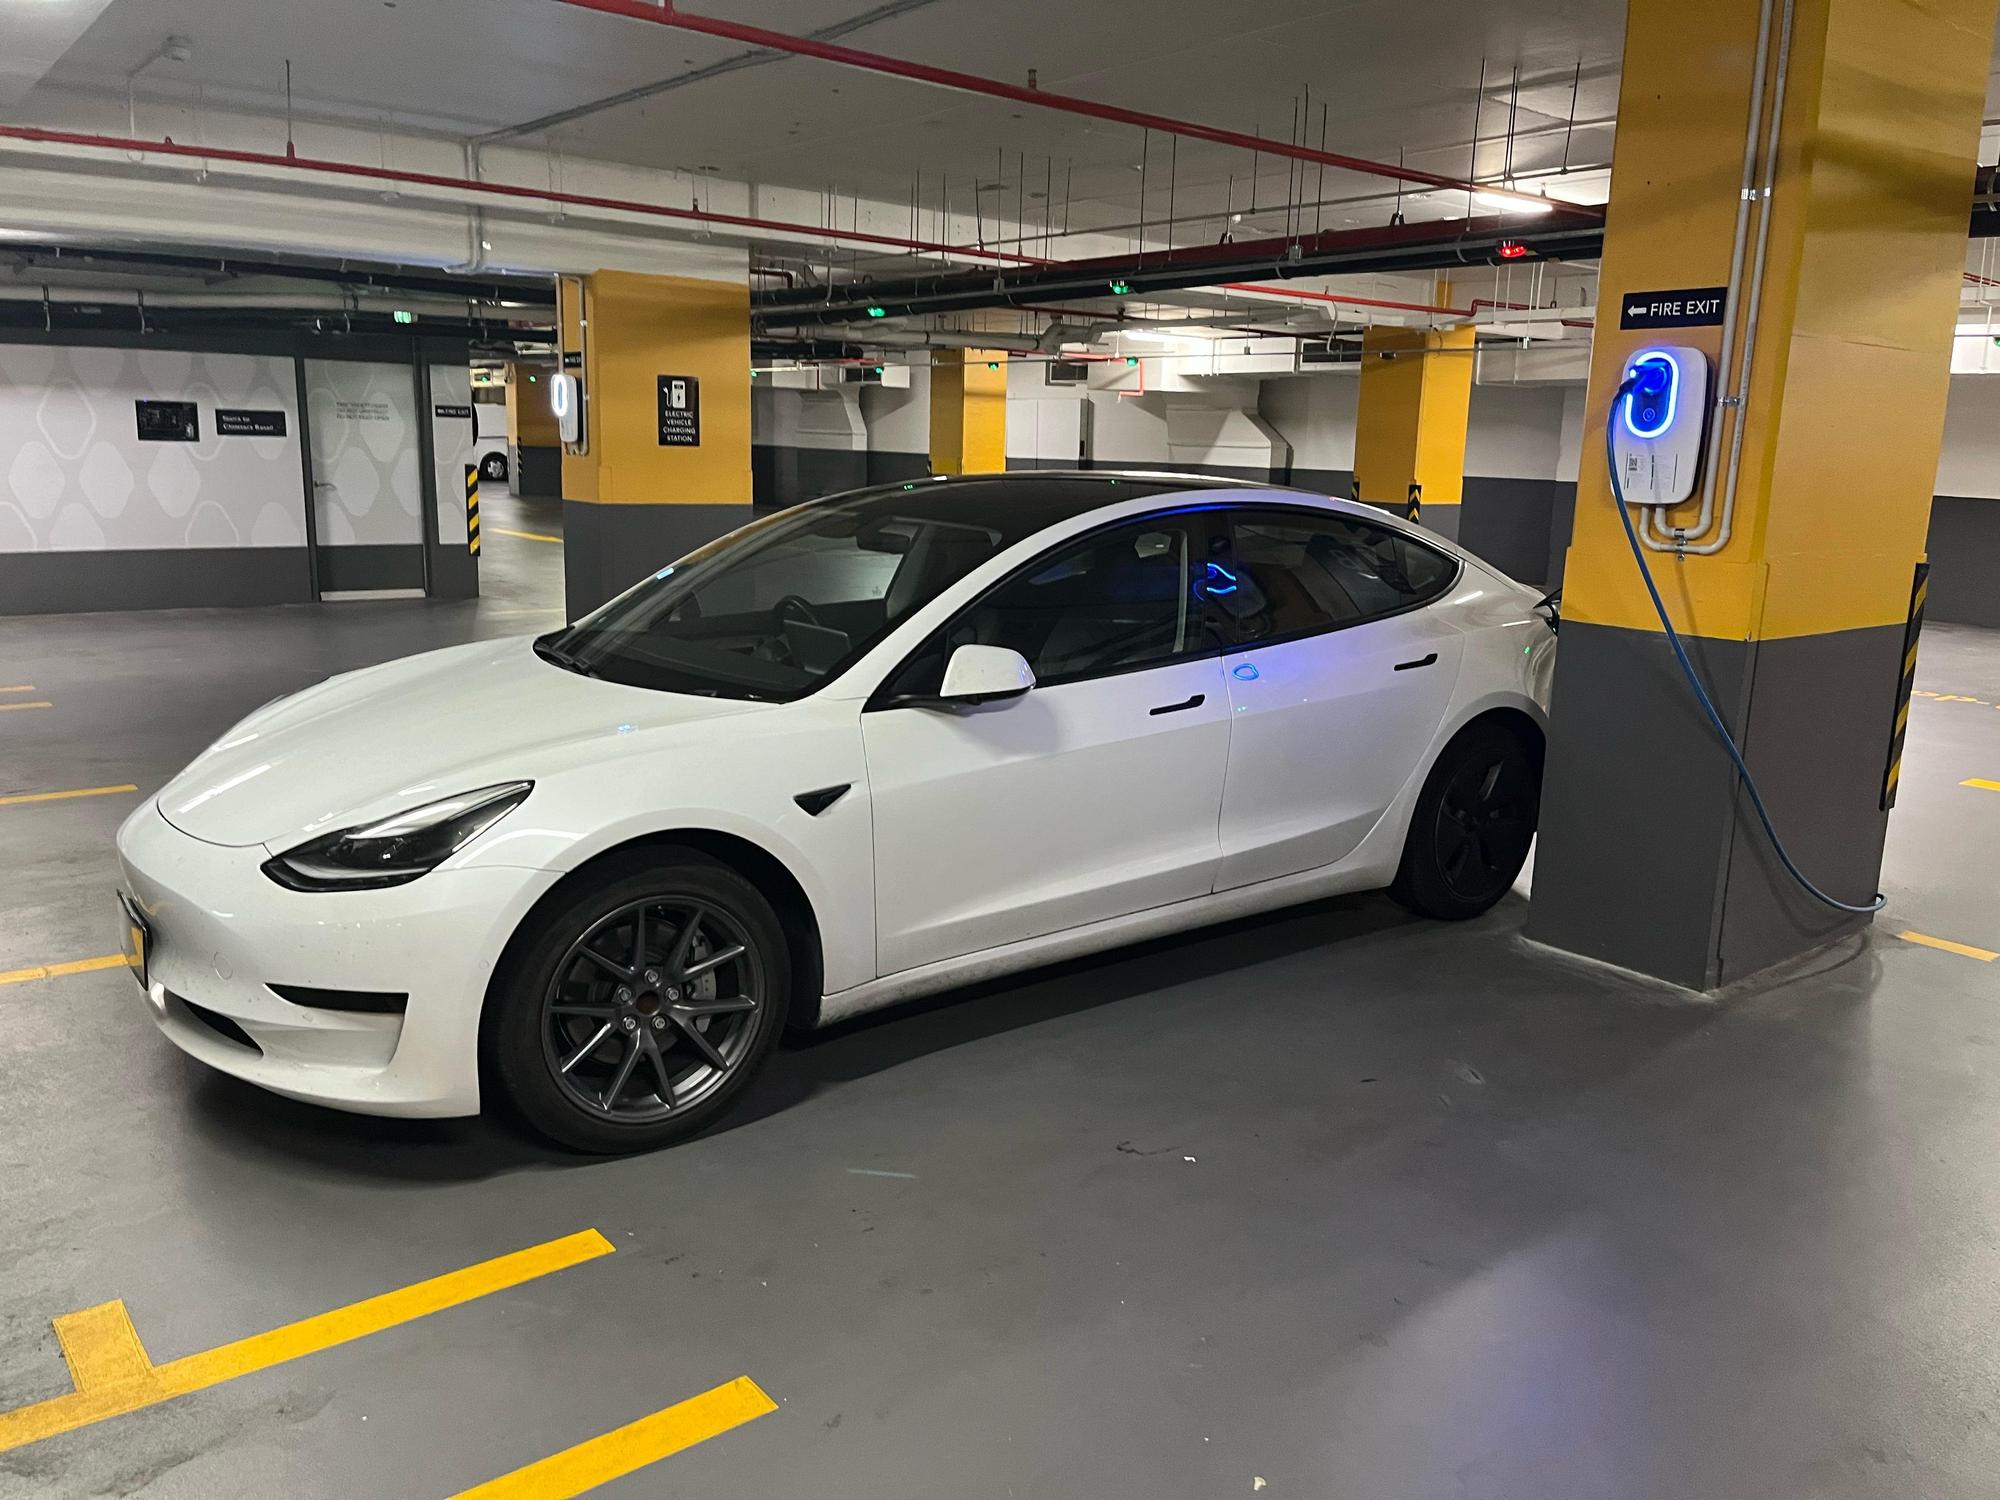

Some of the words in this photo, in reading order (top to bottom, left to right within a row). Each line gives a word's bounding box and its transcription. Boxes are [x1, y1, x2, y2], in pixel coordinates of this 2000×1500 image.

[1650, 301, 1681, 317] FIRE
[1686, 299, 1720, 315] EXIT
[665, 410, 694, 418] ELECTRIC
